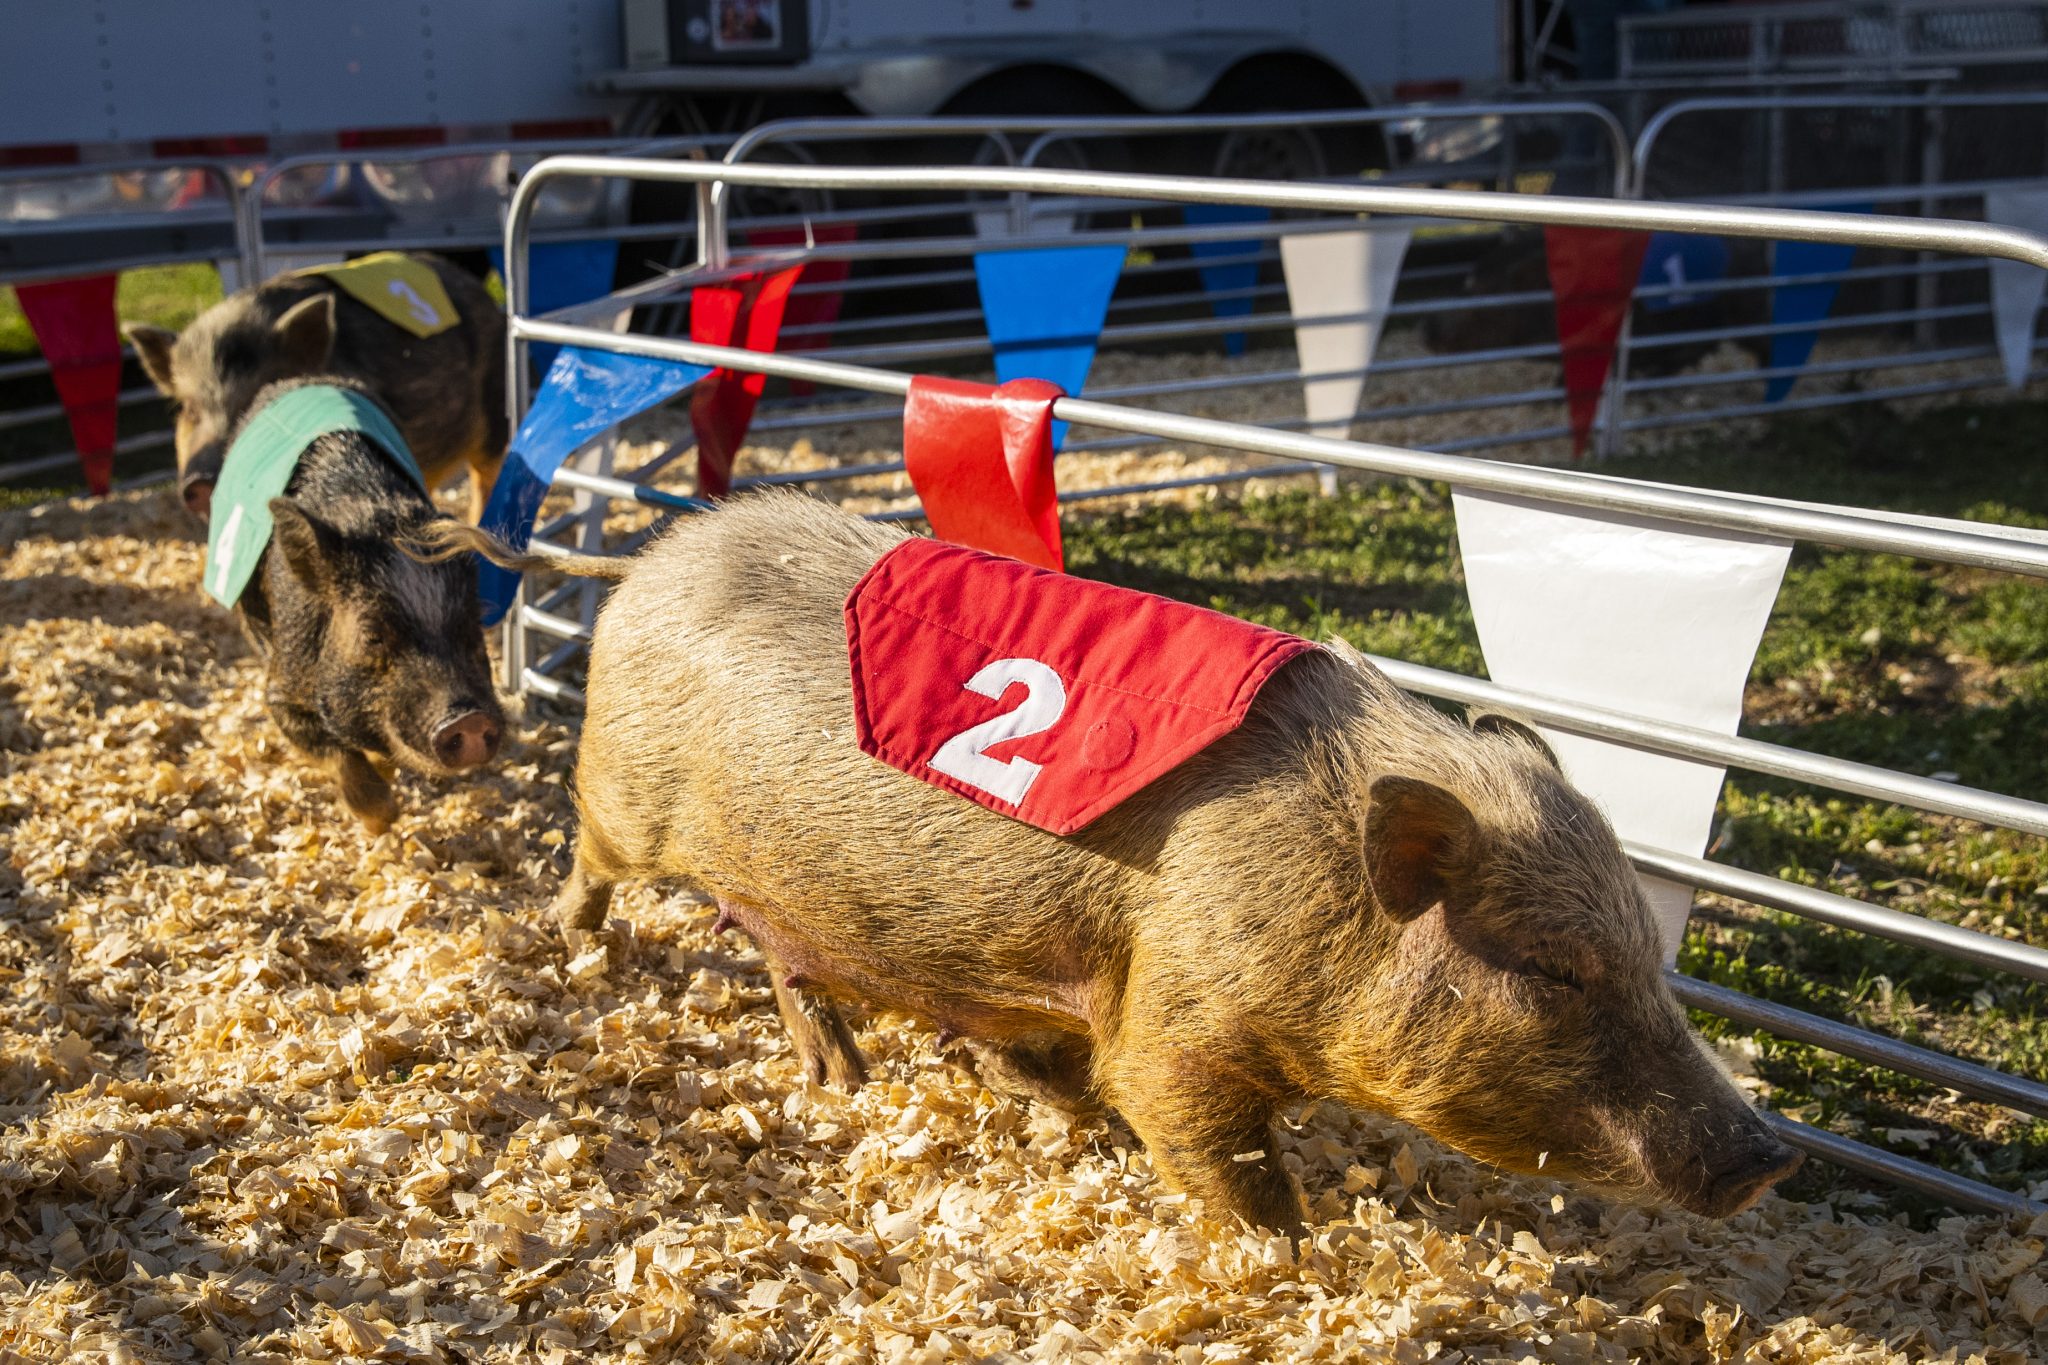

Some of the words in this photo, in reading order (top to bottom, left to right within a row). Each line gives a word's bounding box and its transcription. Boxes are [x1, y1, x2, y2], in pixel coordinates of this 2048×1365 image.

[389, 279, 439, 325] 3
[1663, 254, 1695, 303] 1
[927, 657, 1067, 808] 2
